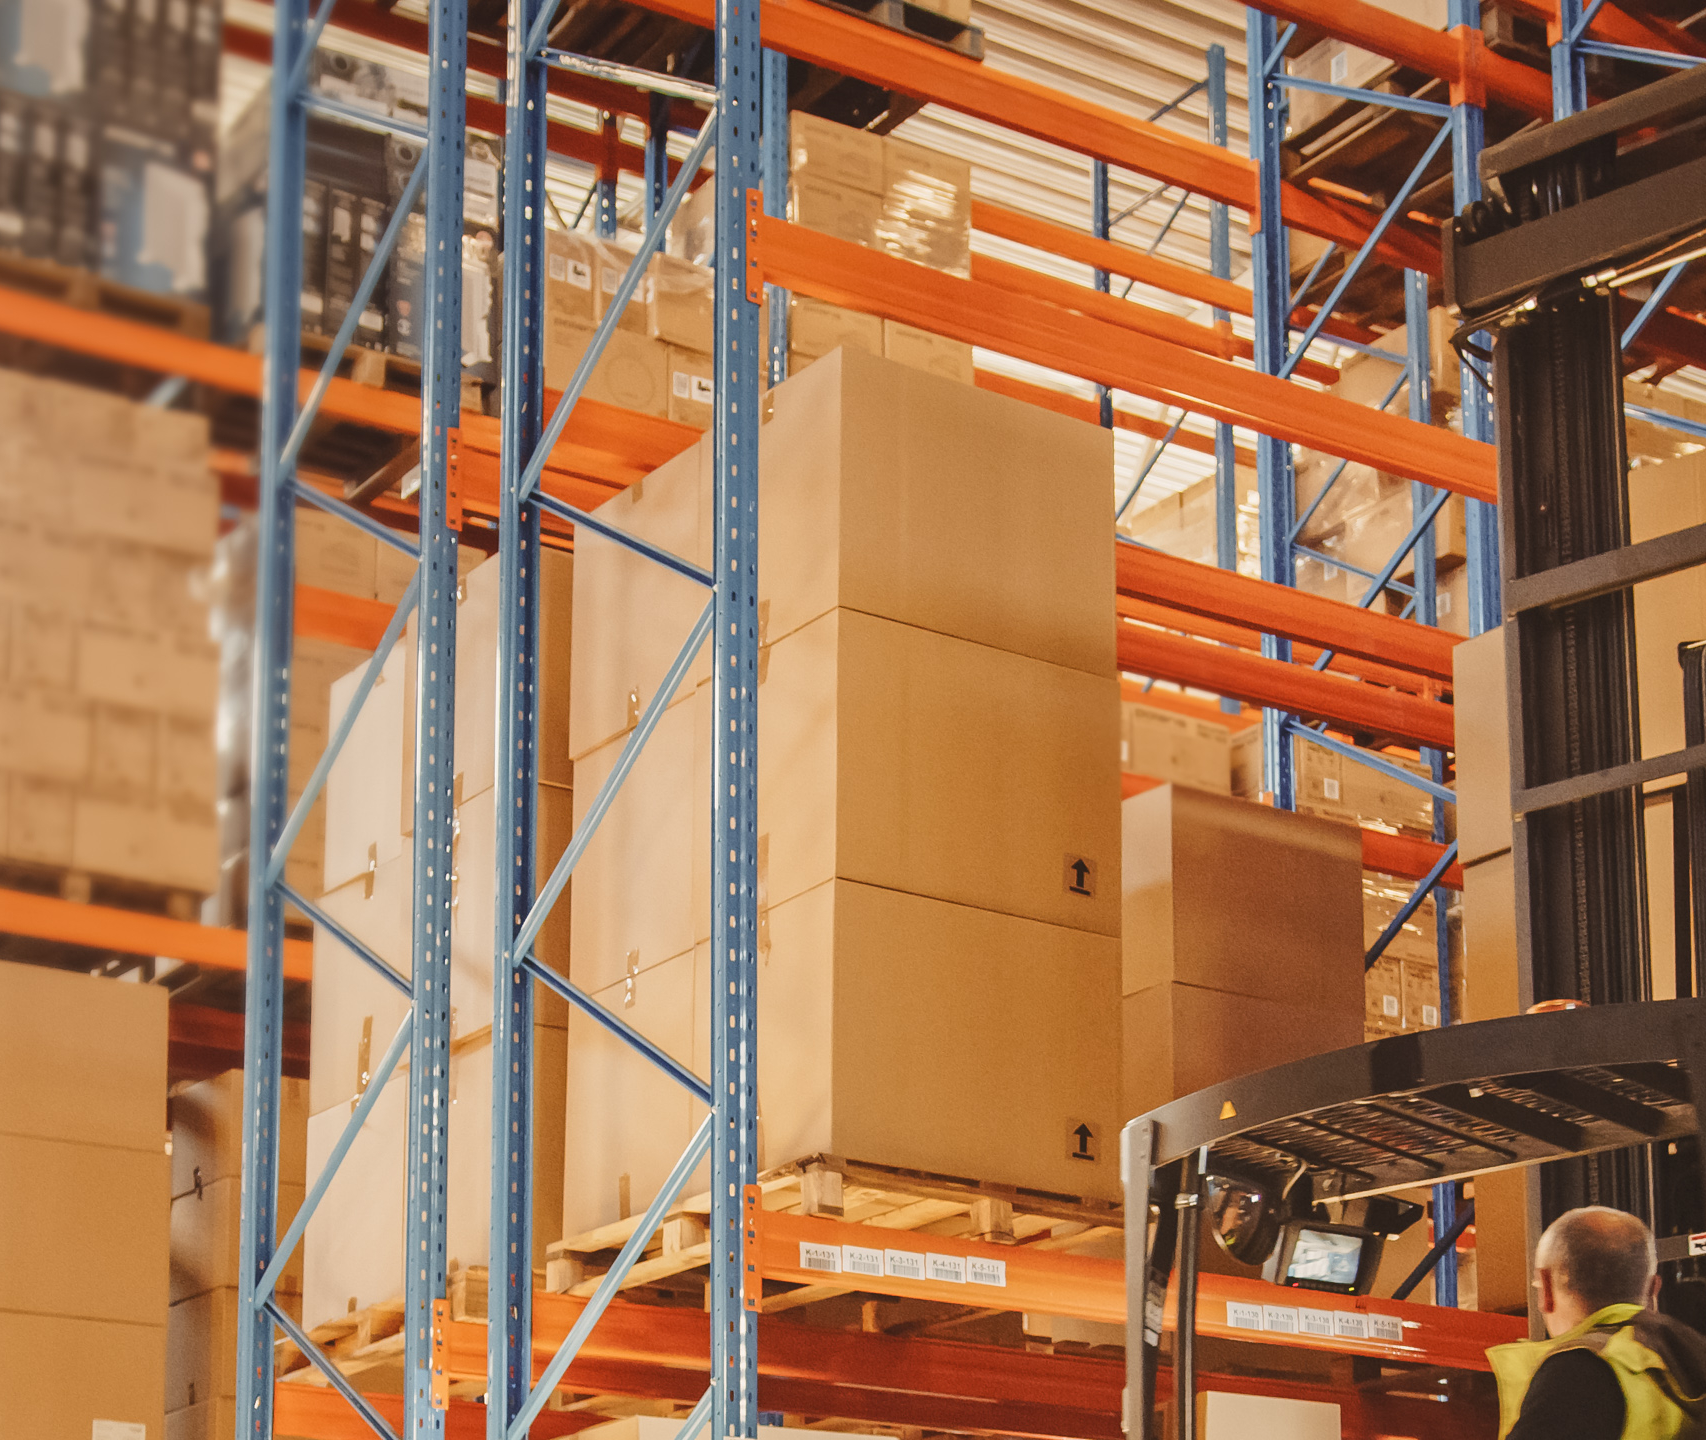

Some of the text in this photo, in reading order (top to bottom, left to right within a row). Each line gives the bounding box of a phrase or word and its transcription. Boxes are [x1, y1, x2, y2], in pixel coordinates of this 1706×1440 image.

[805, 1249, 835, 1259] K-1-131
[850, 1252, 878, 1262] K-2-131
[890, 1255, 918, 1266] K-3-131
[933, 1259, 961, 1270] K-4-131
[972, 1262, 999, 1273] K-5-131
[1233, 1309, 1259, 1318] K-1-130
